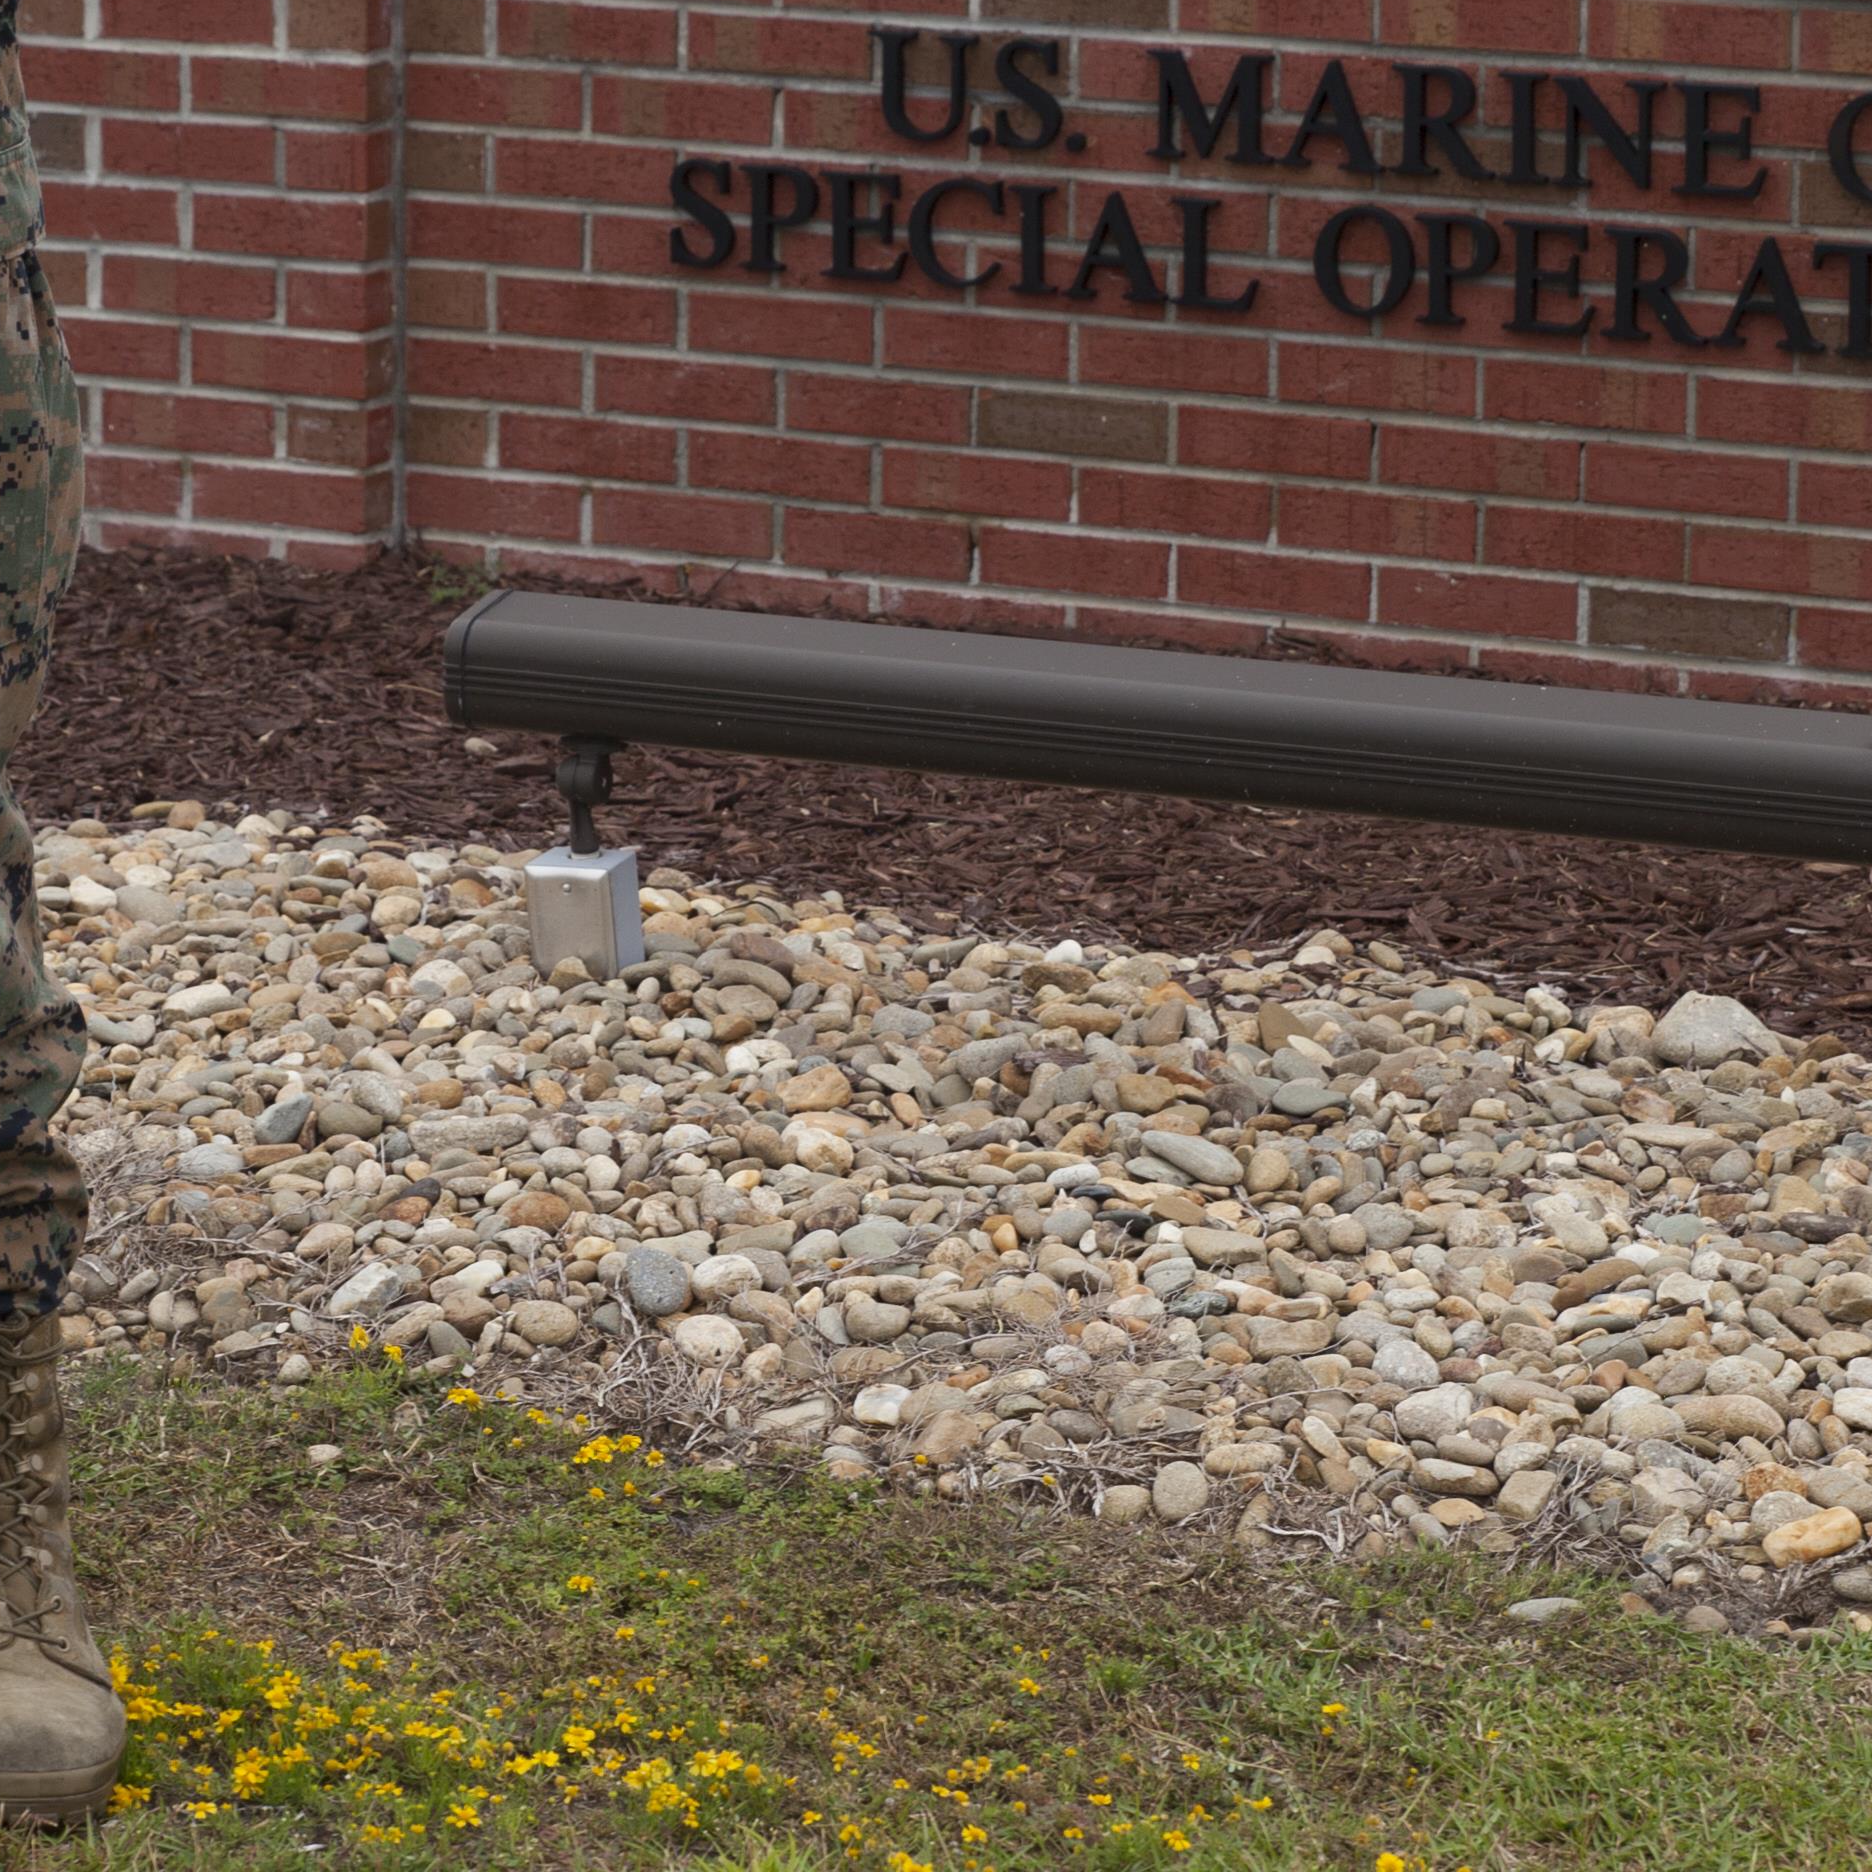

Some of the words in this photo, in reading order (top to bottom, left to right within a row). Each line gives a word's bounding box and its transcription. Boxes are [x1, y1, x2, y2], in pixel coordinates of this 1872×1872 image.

[871, 26, 1088, 154] U.S.
[1146, 47, 1769, 203] MARINE
[669, 156, 1261, 316] SPECIAL
